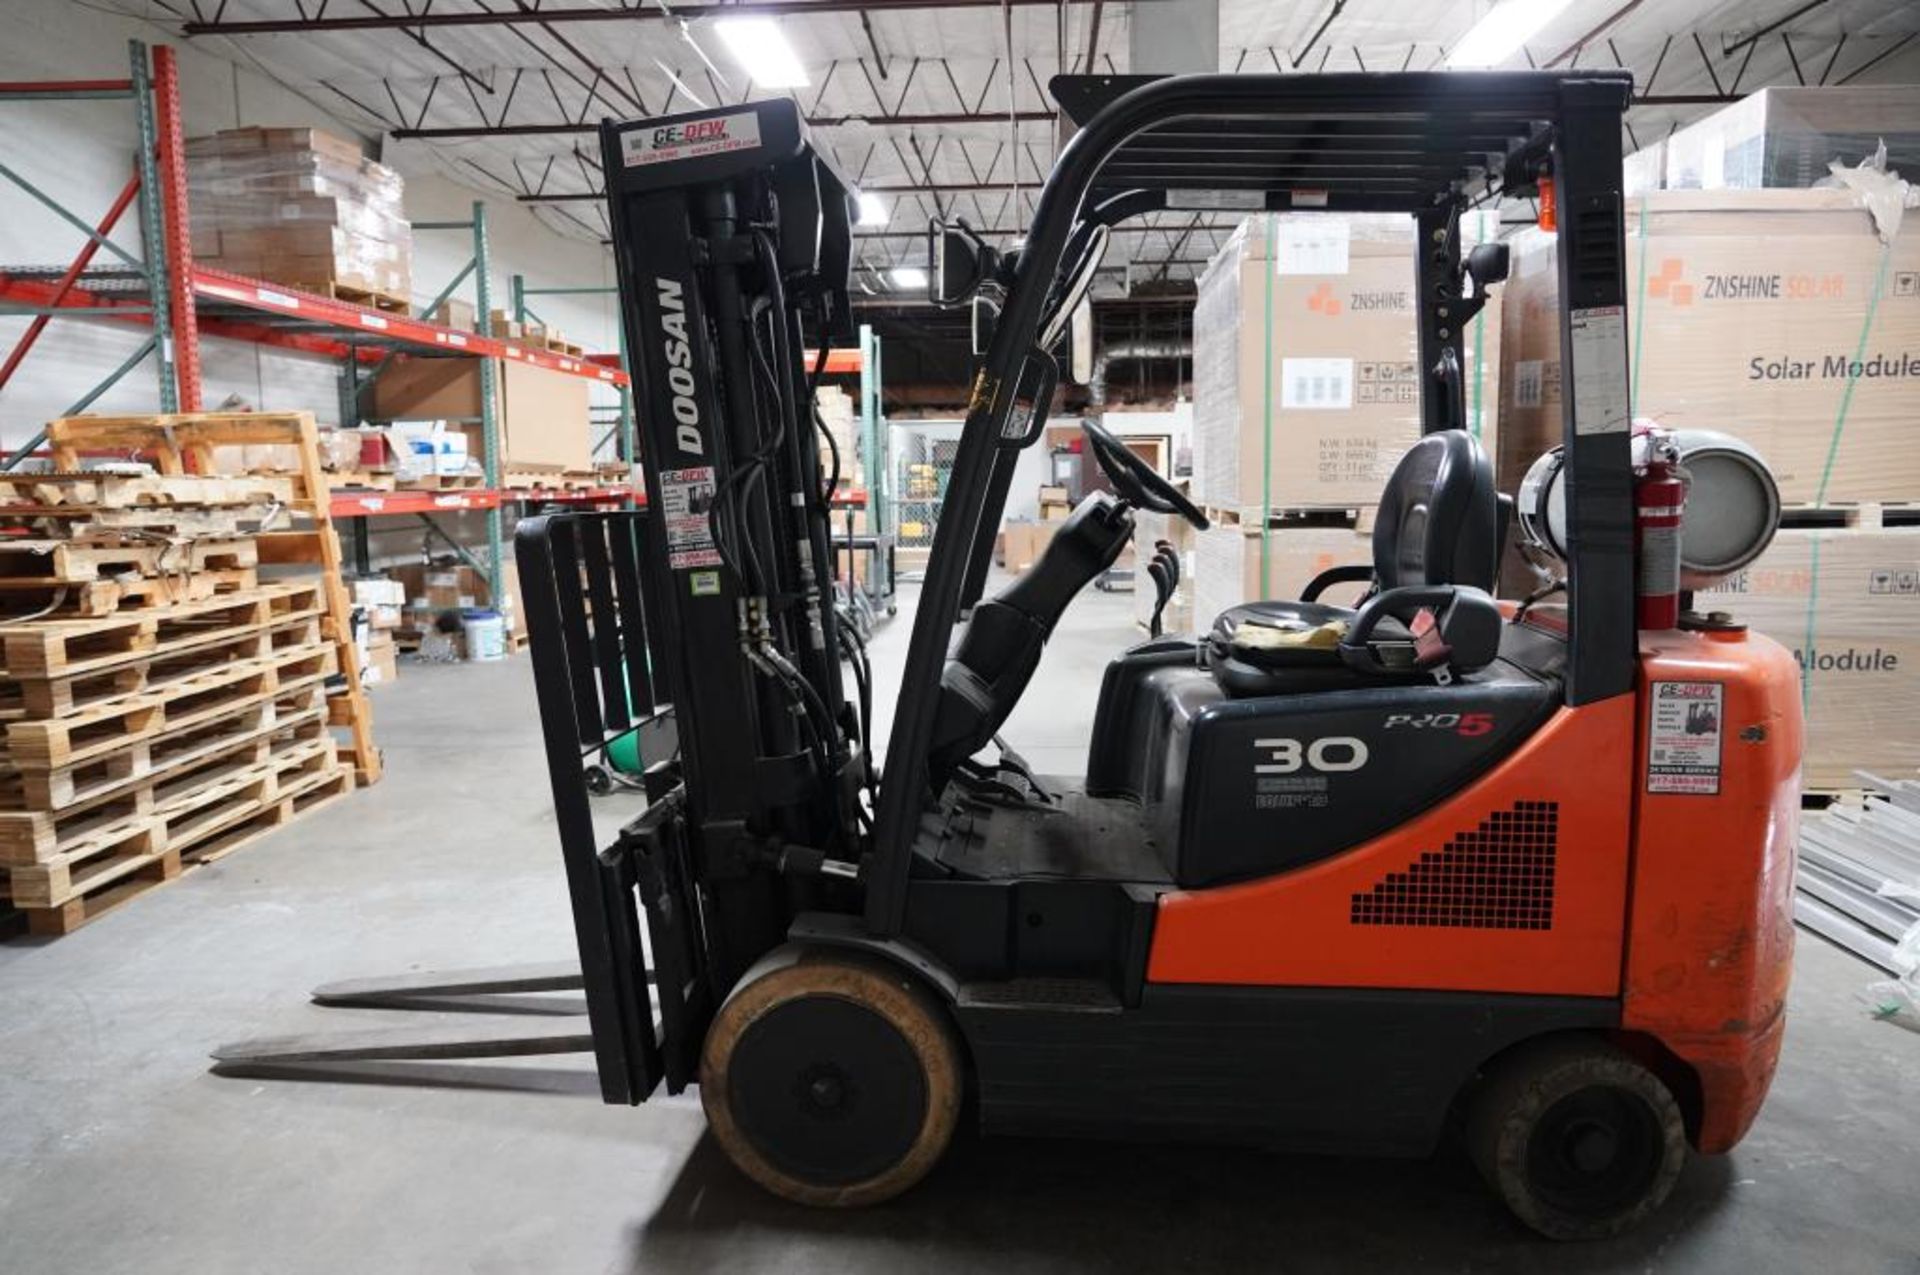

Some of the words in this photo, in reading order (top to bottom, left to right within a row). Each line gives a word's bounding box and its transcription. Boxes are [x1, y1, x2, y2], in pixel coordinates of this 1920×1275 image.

[653, 119, 727, 145] CE-DFW
[1704, 275, 1781, 299] ZNSHINE
[1787, 273, 1845, 298] SOLAR
[1350, 292, 1408, 310] ZNSHINE
[656, 278, 704, 456] DOOSAN
[1749, 356, 1816, 380] Solar
[1822, 353, 1920, 379] Module
[1659, 684, 1714, 697] CE-DFW
[1253, 736, 1369, 774] 30
